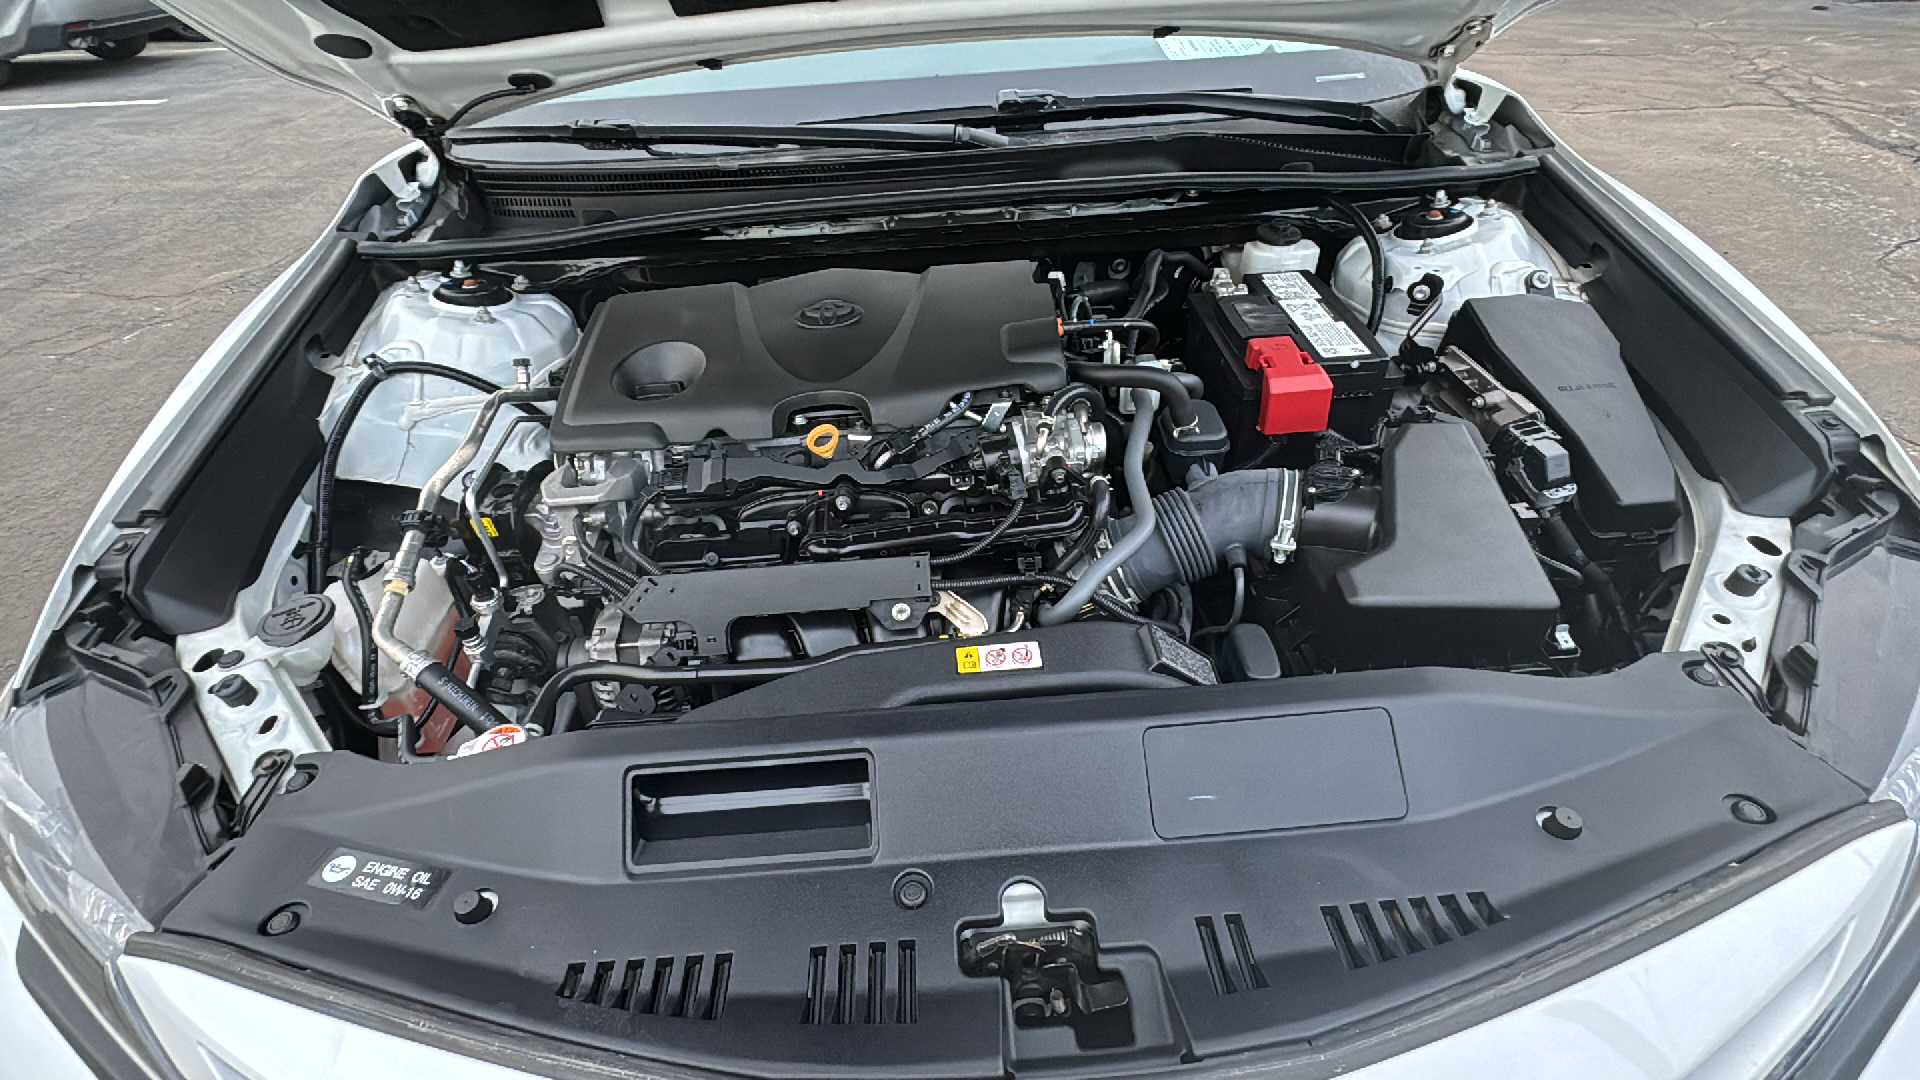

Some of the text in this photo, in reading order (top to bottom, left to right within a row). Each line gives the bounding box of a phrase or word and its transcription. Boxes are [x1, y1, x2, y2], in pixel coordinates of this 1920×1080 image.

[362, 861, 432, 885] ENGINE OIL
[351, 875, 424, 900] SAE 0W-16
